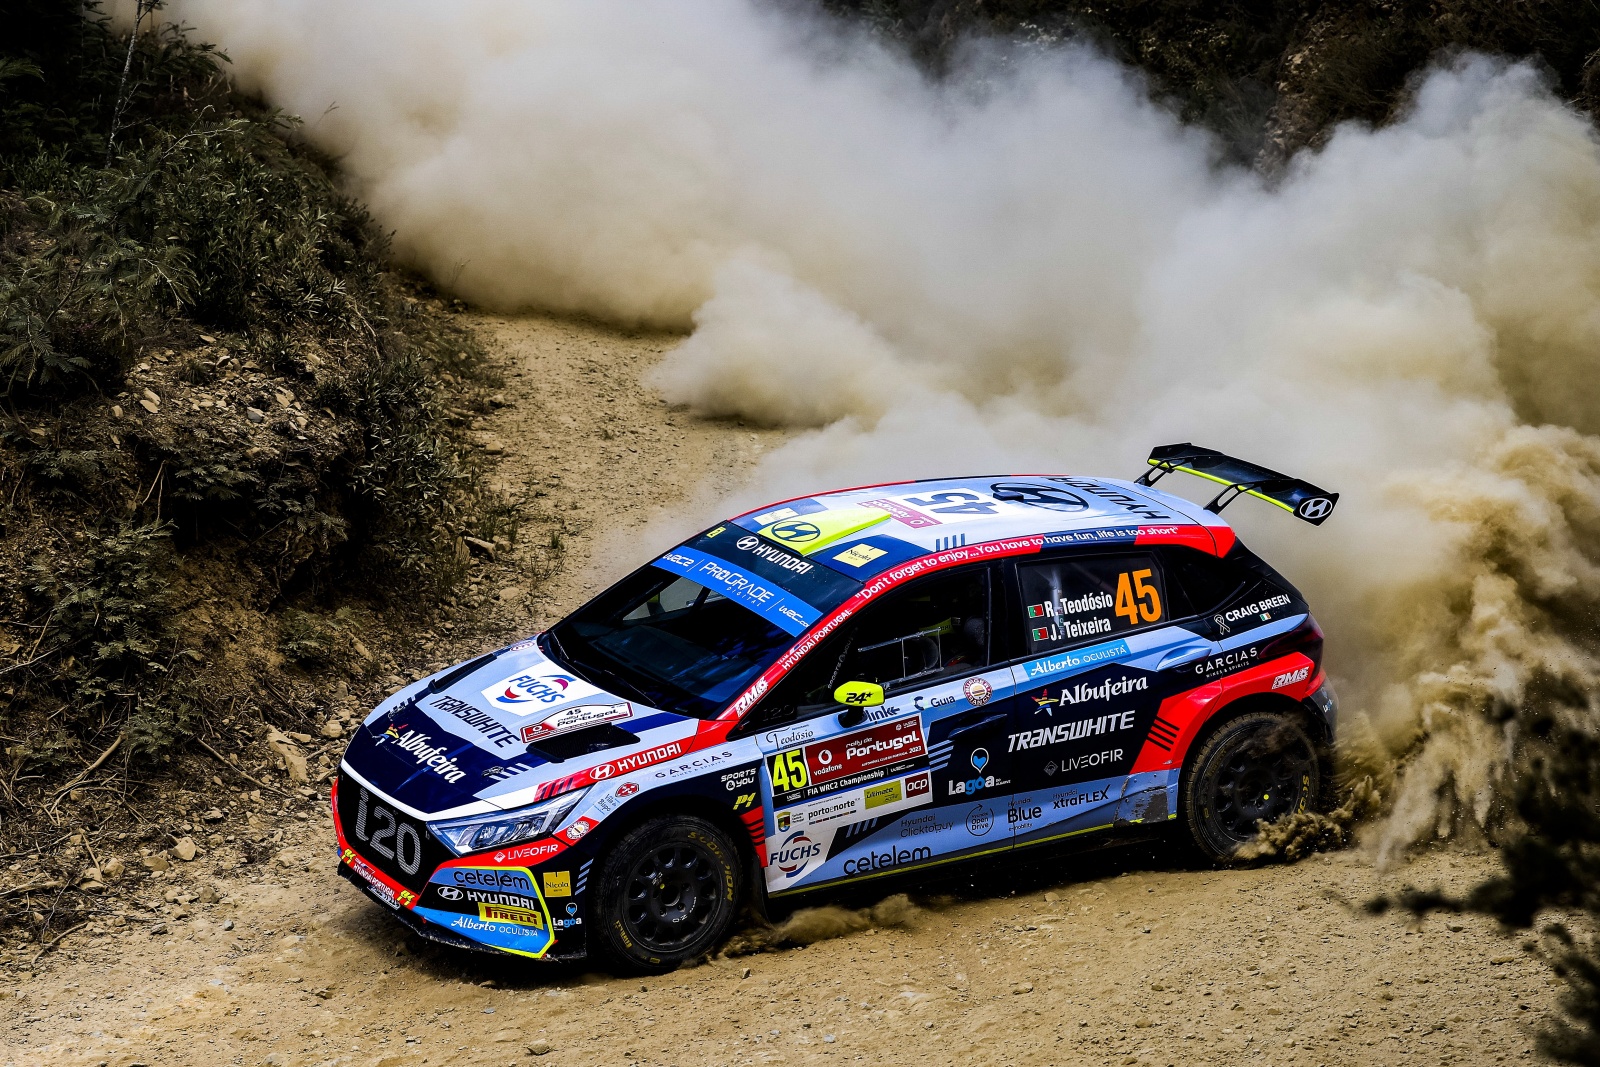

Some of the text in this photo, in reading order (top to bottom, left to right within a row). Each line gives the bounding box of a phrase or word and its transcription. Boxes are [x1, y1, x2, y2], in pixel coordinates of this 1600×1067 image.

[903, 492, 1000, 516] 45
[752, 543, 814, 575] HYUNDAI
[890, 561, 925, 582] forget
[923, 556, 938, 566] to
[1001, 540, 1029, 551] have
[1031, 537, 1044, 548] to
[1044, 533, 1072, 544] have
[1073, 530, 1096, 541] fun,
[1096, 530, 1114, 539] life
[1114, 529, 1125, 537] is
[1126, 527, 1145, 536] too
[726, 586, 762, 607] DIGITAL
[1044, 591, 1113, 618] R. Teodósio
[1115, 568, 1162, 625] 45
[1225, 594, 1291, 622] CRAIG BREEN
[781, 609, 852, 670] HYUNDAI PORTUGAL
[1050, 624, 1062, 641] J.
[1064, 616, 1111, 639] Teixeira
[1031, 655, 1080, 676] Alberto
[1195, 647, 1258, 674] GARCIAS
[508, 674, 565, 704] FUCHS
[1059, 675, 1149, 707] Albufeira
[429, 695, 520, 748] TRANSWHITE
[566, 708, 582, 716] 45
[765, 727, 814, 751] Teodósio
[1007, 709, 1136, 753] TRANSWHITE
[391, 729, 466, 784] Albufeira
[617, 742, 682, 771] HYUNDAI
[846, 739, 863, 749] rally
[846, 730, 920, 760] Portugal
[655, 751, 733, 778] GARCIAS
[772, 749, 808, 792] 45
[813, 763, 843, 776] vodafone
[1061, 748, 1124, 773] LIVEOFIR
[720, 767, 757, 782] SPORTS
[735, 776, 754, 788] YOU
[807, 785, 819, 796] FIA
[820, 781, 838, 793] WRC2
[840, 768, 884, 788] Championship
[906, 778, 928, 792] acp
[948, 775, 995, 795] Lagoa
[1053, 783, 1111, 810] xtraFLEX
[901, 812, 936, 827] Hyundai
[971, 817, 989, 826] Open
[971, 822, 989, 831] Drive
[1007, 805, 1042, 824] Blue
[355, 787, 421, 876] i20
[507, 843, 559, 860] LIVEOFIR
[769, 842, 822, 865] FUCHS
[843, 845, 932, 876] cetelem
[353, 862, 373, 884] HYUNDAI
[371, 876, 395, 900] PORTUGAL
[453, 870, 530, 890] cetelem
[467, 890, 534, 910] HYUNDAI
[451, 915, 496, 932] Alberto
[485, 906, 538, 925] PIRELLI
[552, 917, 582, 928] Lagoa
